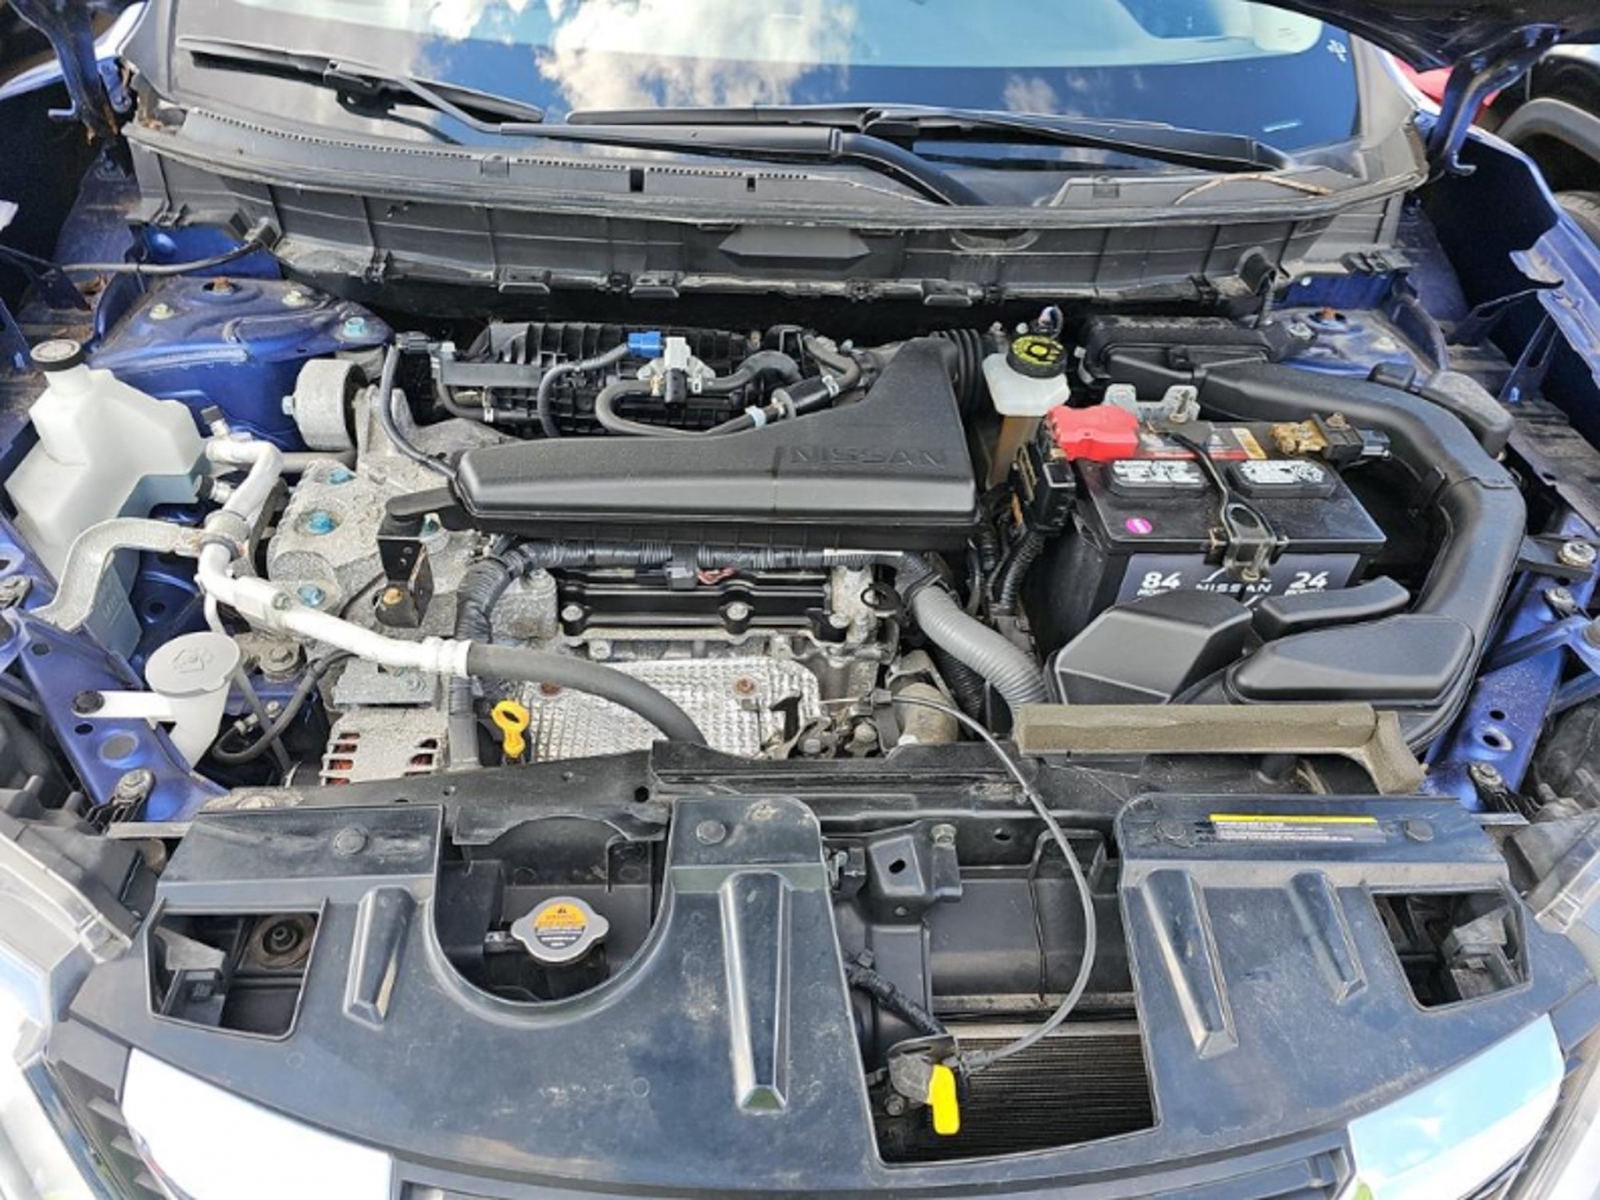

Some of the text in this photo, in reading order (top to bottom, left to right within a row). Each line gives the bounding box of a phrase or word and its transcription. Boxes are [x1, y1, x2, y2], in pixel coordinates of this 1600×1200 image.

[790, 447, 946, 468] NISSAN
[1142, 571, 1181, 590] 84
[1195, 583, 1272, 593] NISSAN
[1289, 571, 1329, 589] 24
